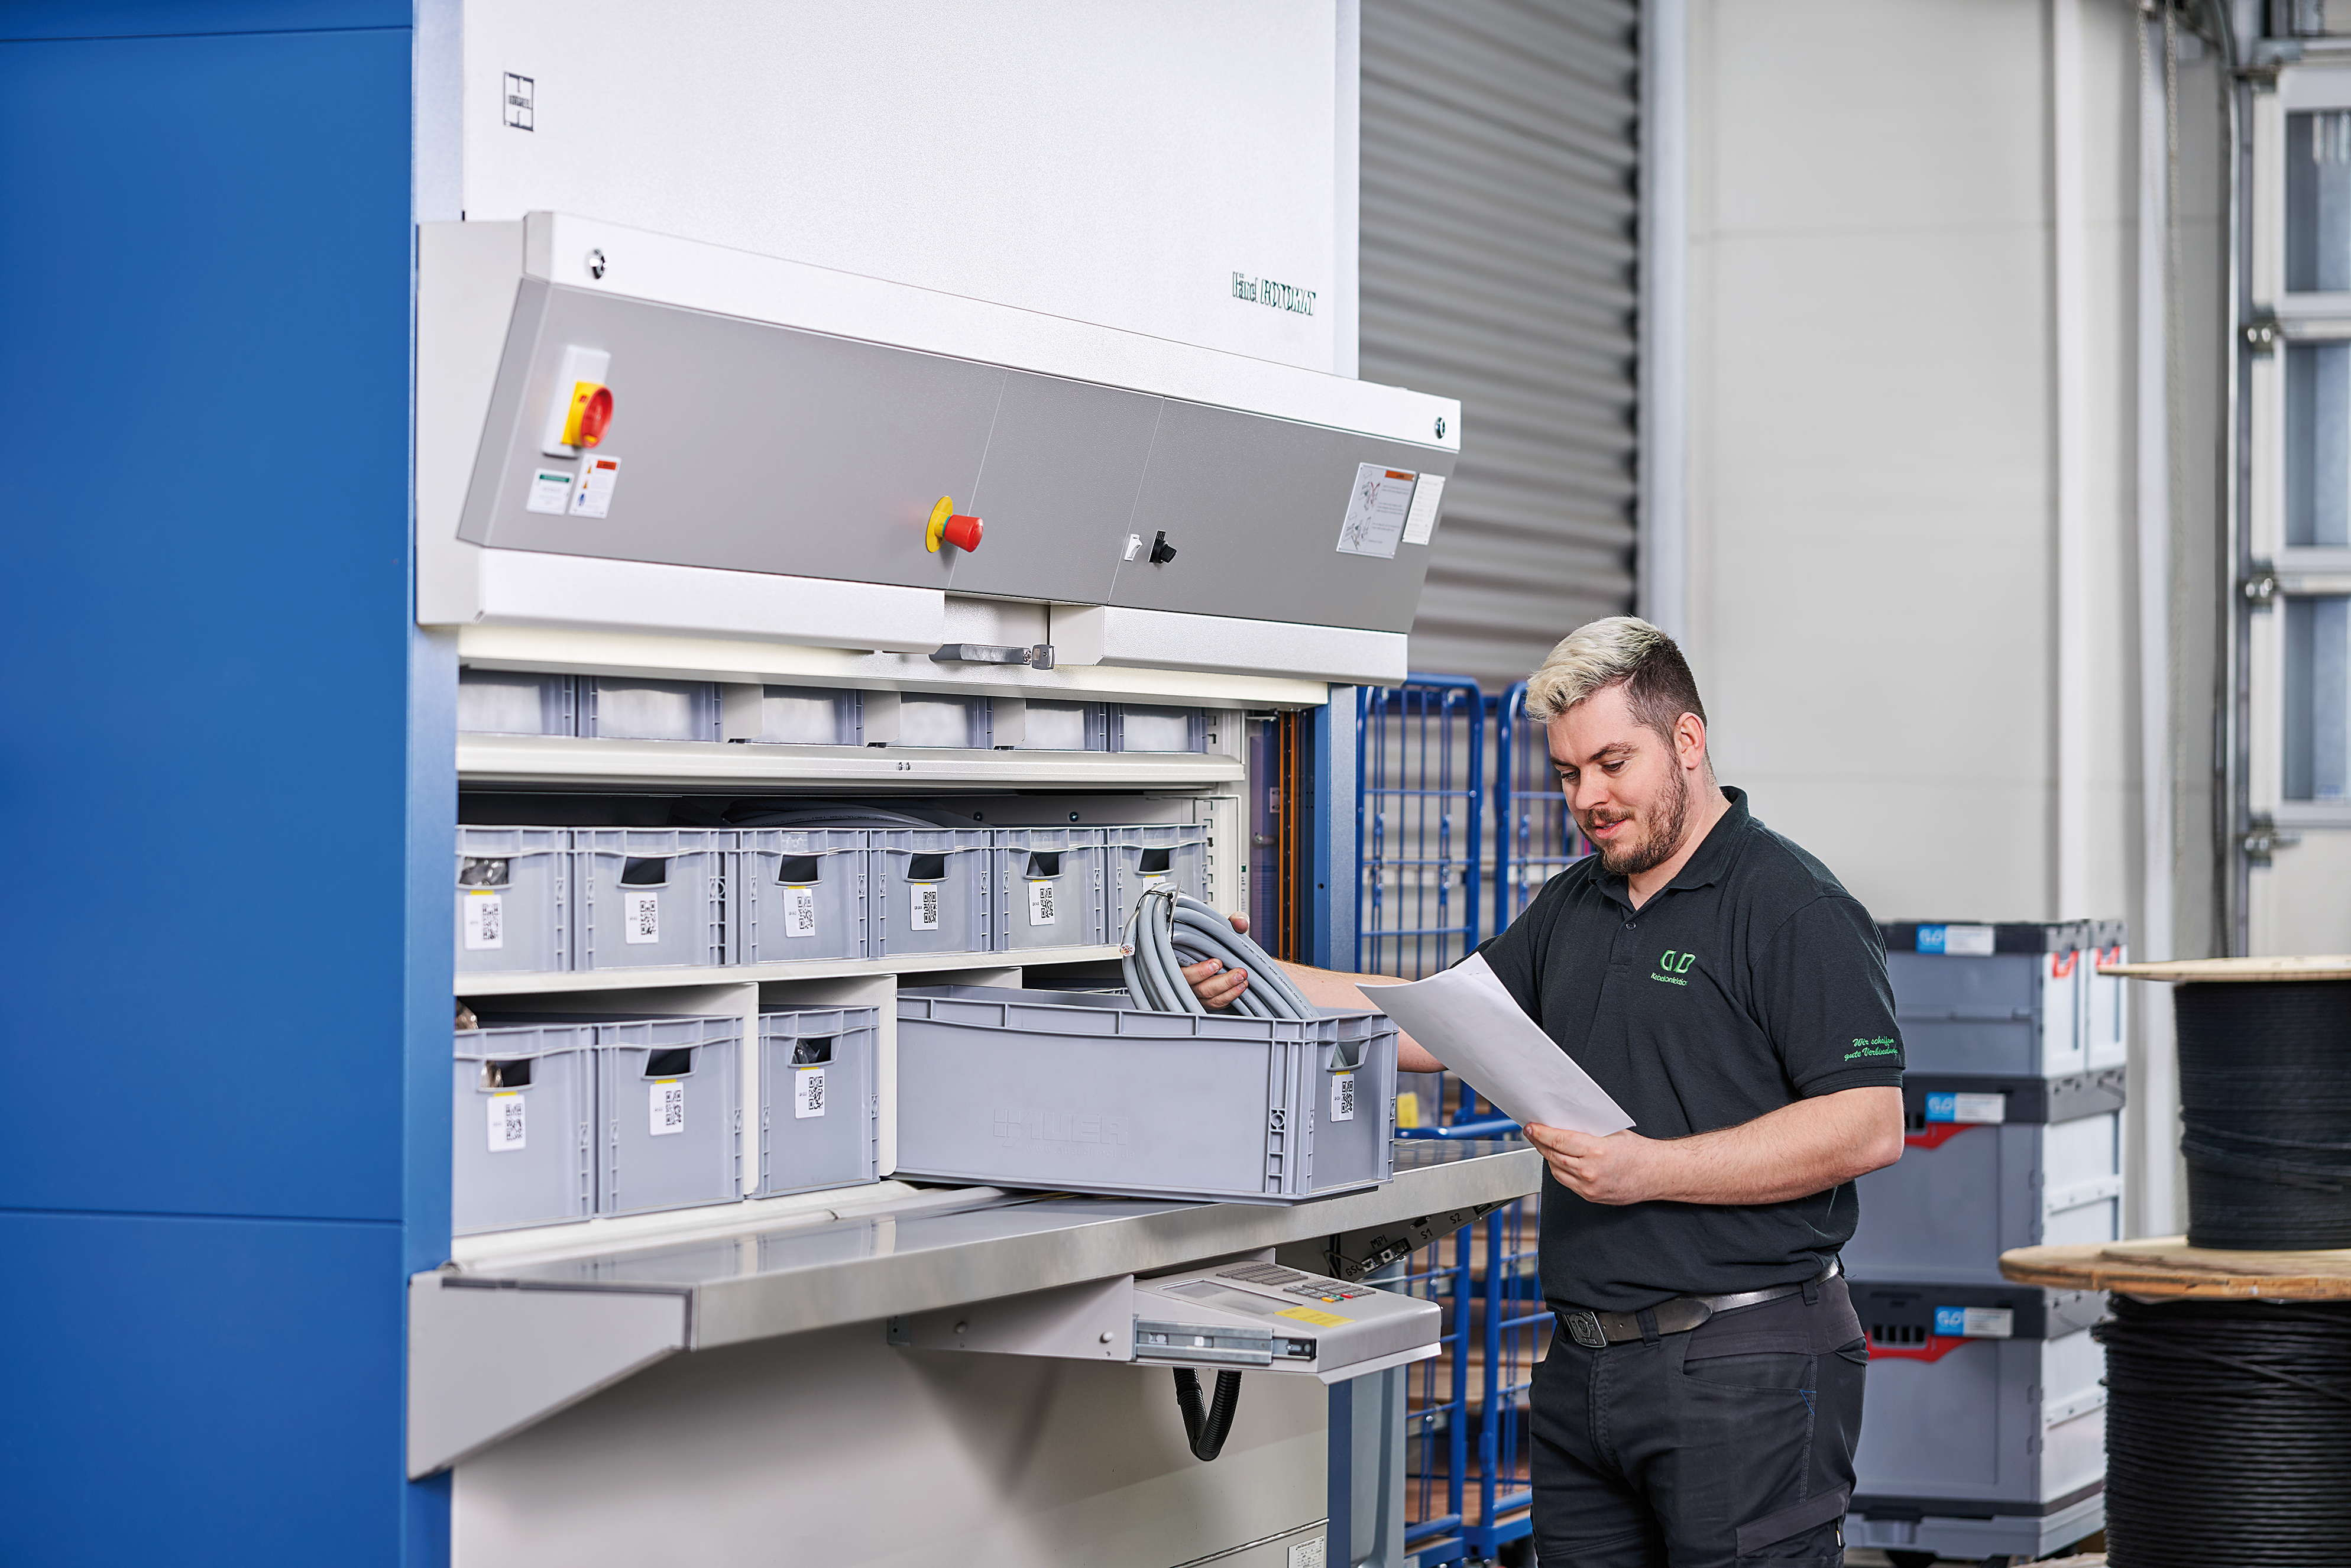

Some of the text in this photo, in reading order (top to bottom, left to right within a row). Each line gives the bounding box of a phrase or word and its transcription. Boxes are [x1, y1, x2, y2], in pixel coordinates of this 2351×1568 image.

[1260, 278, 1316, 316] ROTOMAT
[1852, 1038, 1869, 1047] Wir
[1844, 1050, 1861, 1061] gute
[1449, 1213, 1462, 1224] S2
[1420, 1228, 1433, 1239] S1
